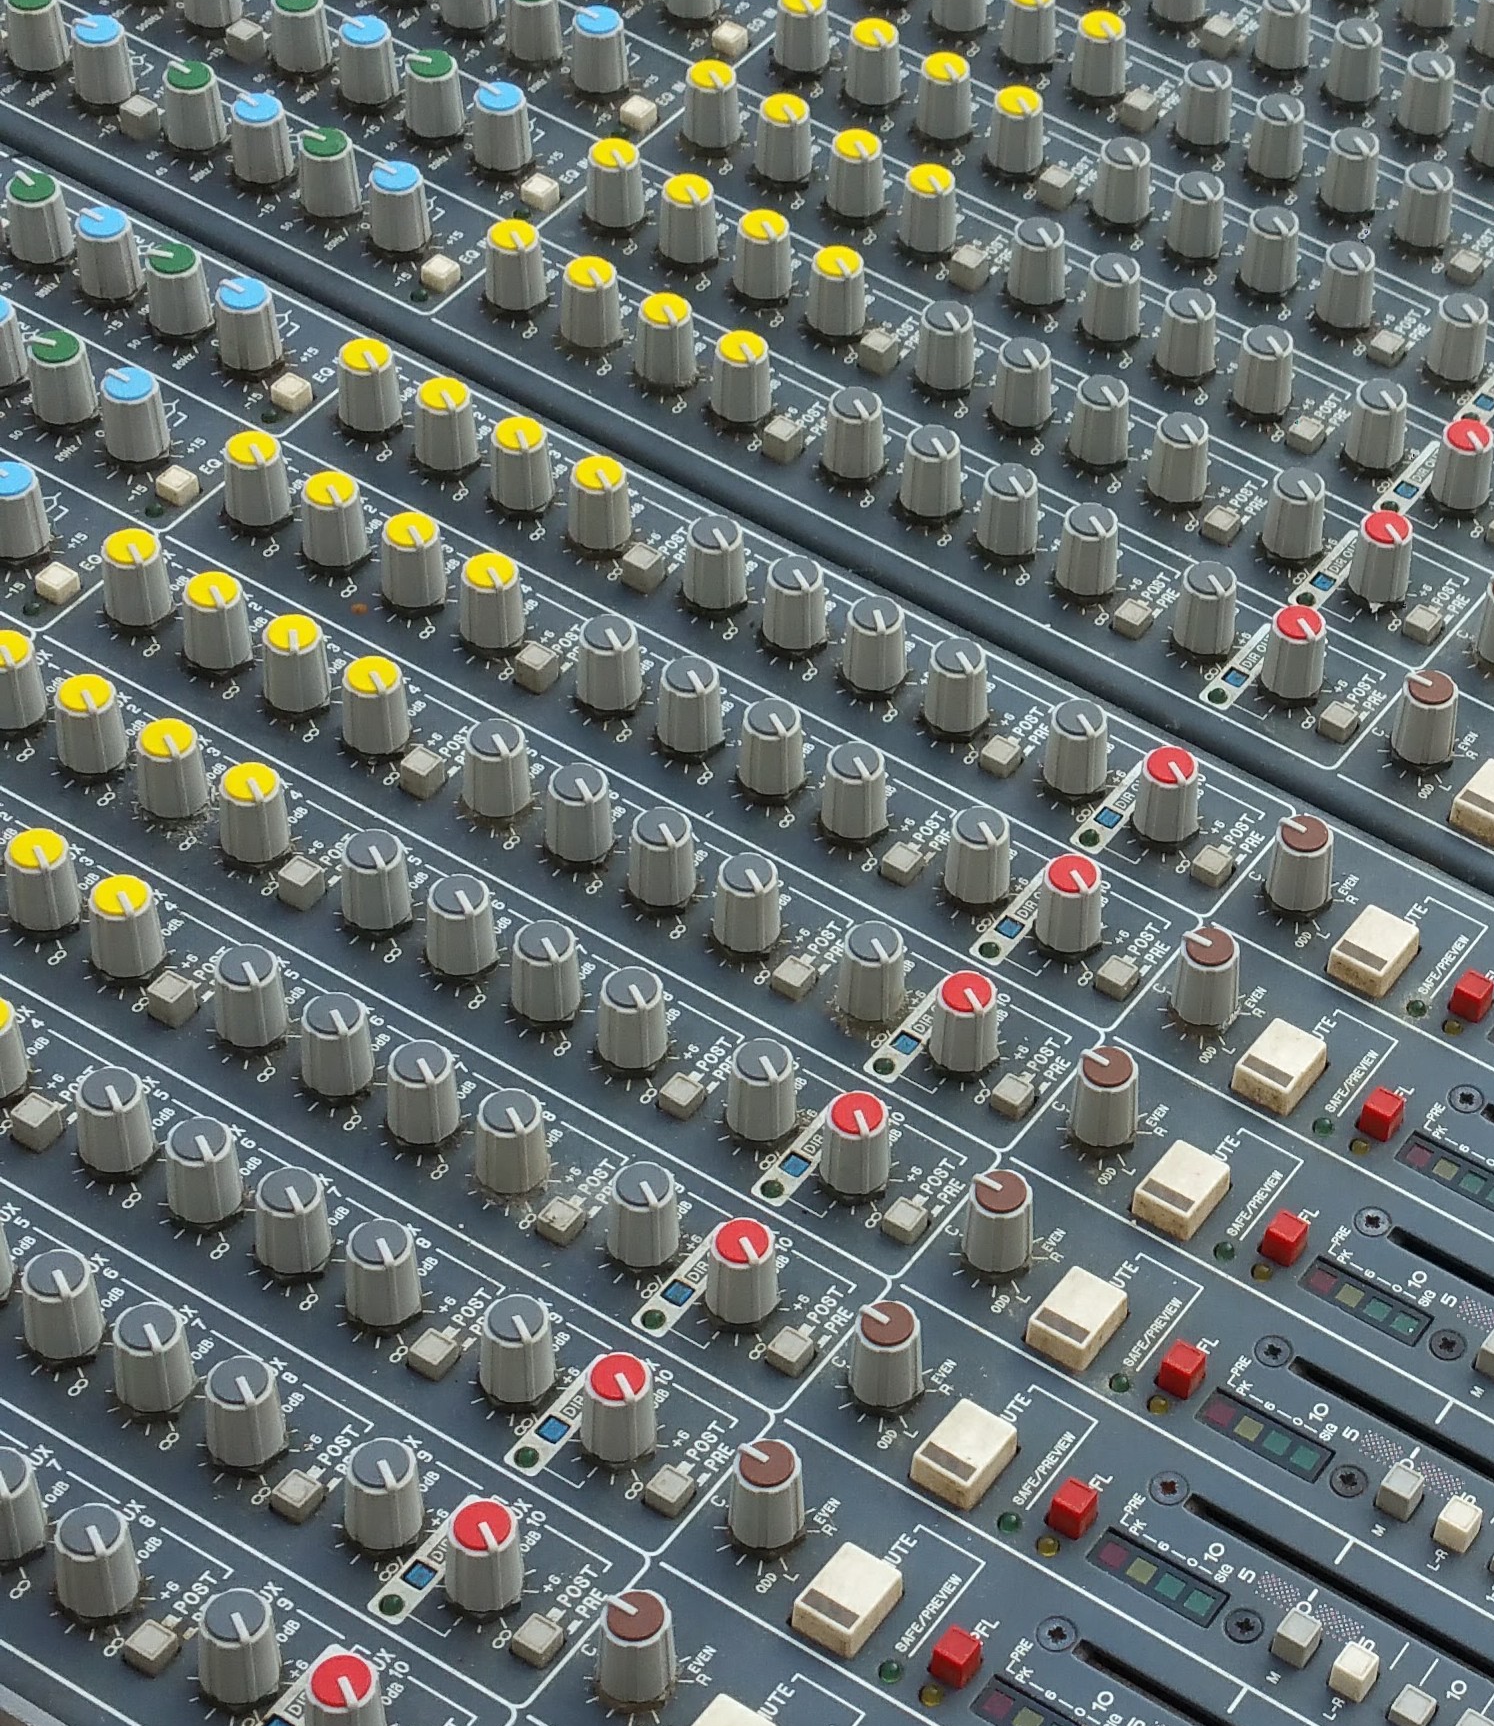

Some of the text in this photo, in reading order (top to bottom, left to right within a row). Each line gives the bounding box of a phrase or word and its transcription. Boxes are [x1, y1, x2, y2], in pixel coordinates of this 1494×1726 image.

[1226, 811, 1263, 851] POST
[1418, 935, 1470, 995] SAFE/PREVIEW
[1324, 1050, 1378, 1113] SAFE/PREVIEW
[919, 1158, 956, 1200] POST
[808, 1286, 842, 1331] POST
[825, 1308, 854, 1334] PRE
[1123, 1297, 1182, 1368] SAFE/PREVIEW
[931, 1360, 958, 1388] EVEN
[1308, 1402, 1329, 1425] 10
[319, 1424, 361, 1467] POST
[686, 1420, 726, 1467] POST
[1342, 1426, 1360, 1441] 5
[705, 1444, 734, 1469] PRE
[1012, 1432, 1075, 1507] SAFE/PREVIEW
[527, 1508, 548, 1525] 10
[813, 1498, 841, 1526] EVEN
[1126, 1491, 1145, 1519] PRE
[1128, 1520, 1146, 1537] PK
[1203, 1543, 1225, 1565] 10
[1428, 1548, 1449, 1572] L-R
[542, 1574, 561, 1594] +6
[561, 1563, 600, 1610] POST
[1214, 1563, 1234, 1584] SIG
[1237, 1567, 1256, 1584] 5
[174, 1570, 219, 1616] POST
[576, 1589, 607, 1619] PRE
[895, 1574, 963, 1655] SAFE/PREVIEW
[688, 1646, 717, 1674] EVEN
[1012, 1636, 1034, 1664] PRE
[389, 1661, 410, 1677] 10
[1015, 1666, 1034, 1686] PK
[1266, 1671, 1281, 1685] M
[1091, 1690, 1114, 1714] 10
[1447, 1679, 1469, 1701] 10
[1323, 1697, 1345, 1721] L-R
